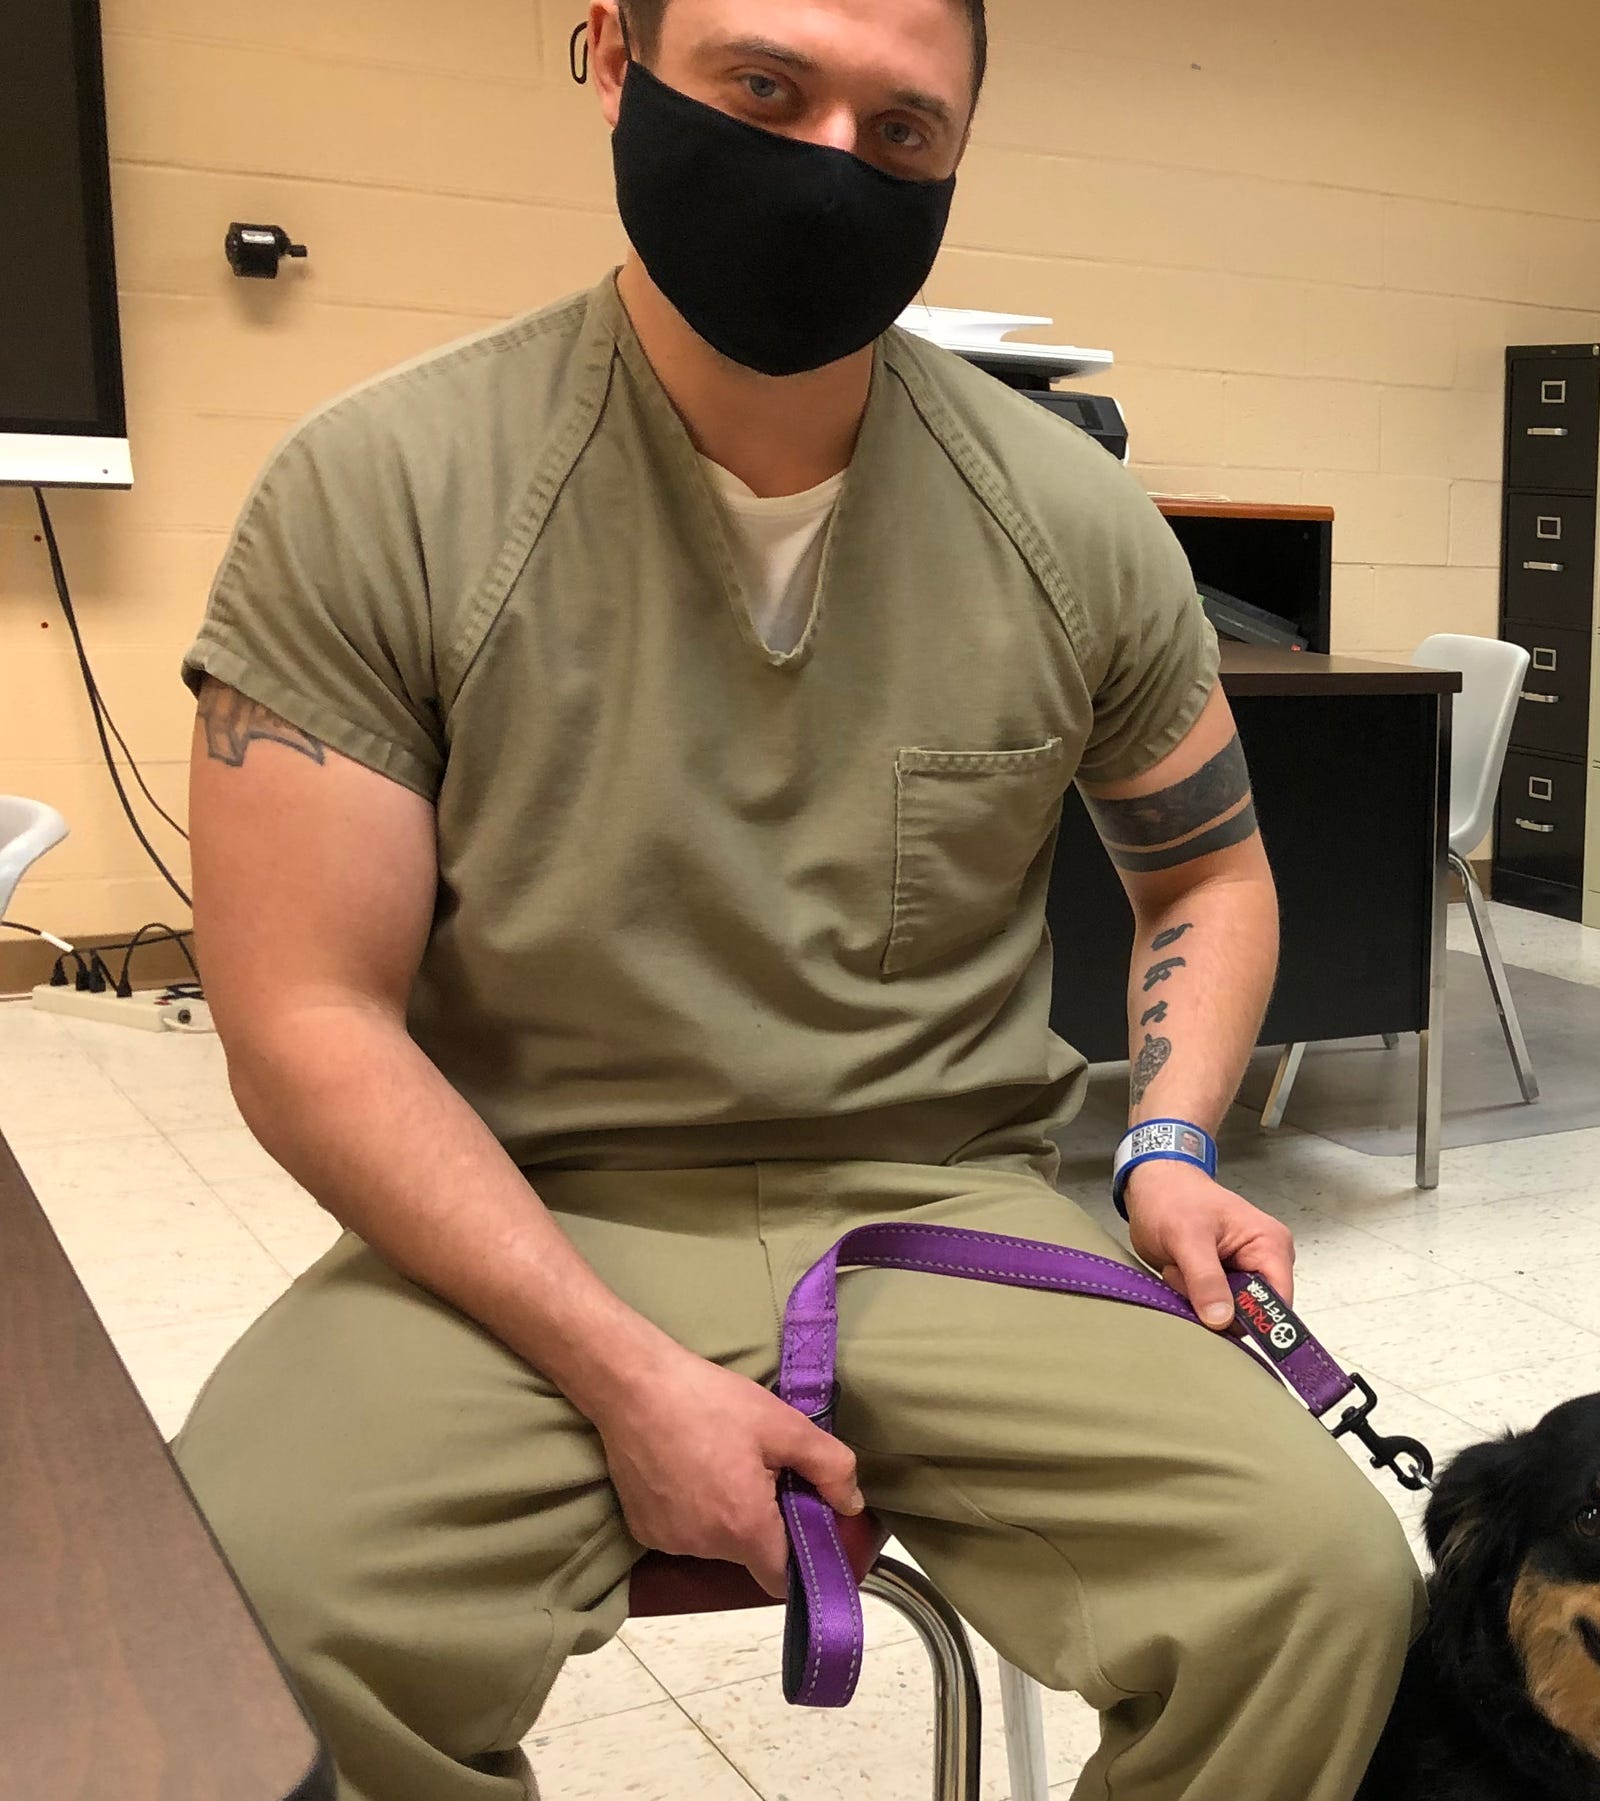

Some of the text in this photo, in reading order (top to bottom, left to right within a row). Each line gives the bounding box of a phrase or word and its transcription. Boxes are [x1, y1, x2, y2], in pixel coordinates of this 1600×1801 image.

[1237, 1290, 1275, 1334] PRIMAL
[1247, 1280, 1286, 1323] PET GEAR
